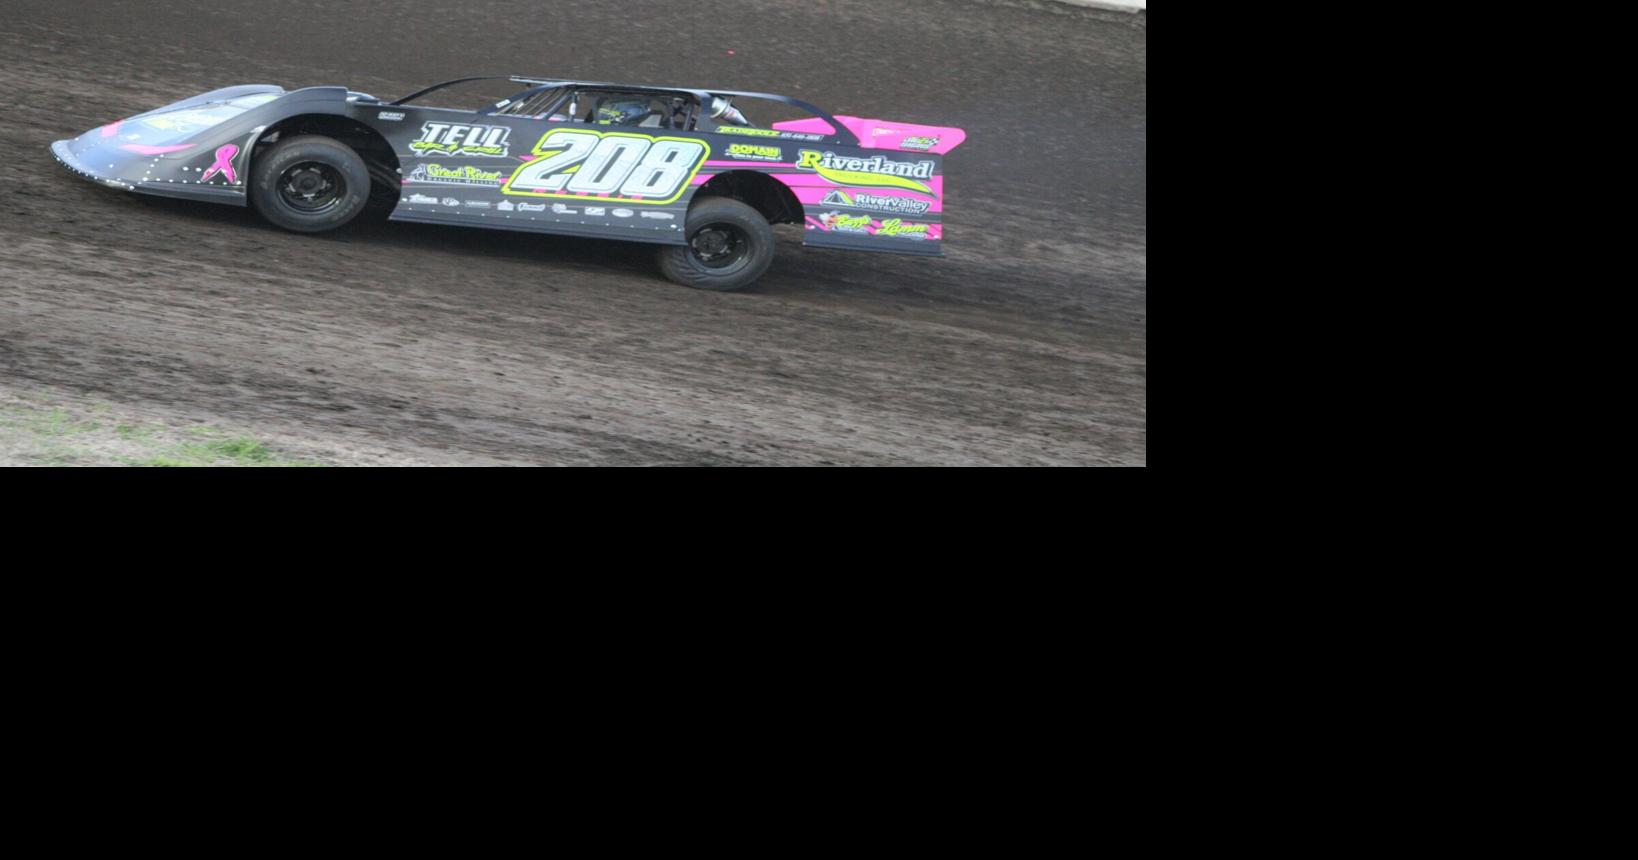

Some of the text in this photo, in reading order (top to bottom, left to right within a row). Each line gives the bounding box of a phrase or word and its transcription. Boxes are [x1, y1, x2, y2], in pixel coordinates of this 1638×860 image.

[422, 121, 509, 147] TELL
[465, 165, 502, 180] River
[506, 130, 706, 199] 208
[799, 150, 933, 179] Riverland
